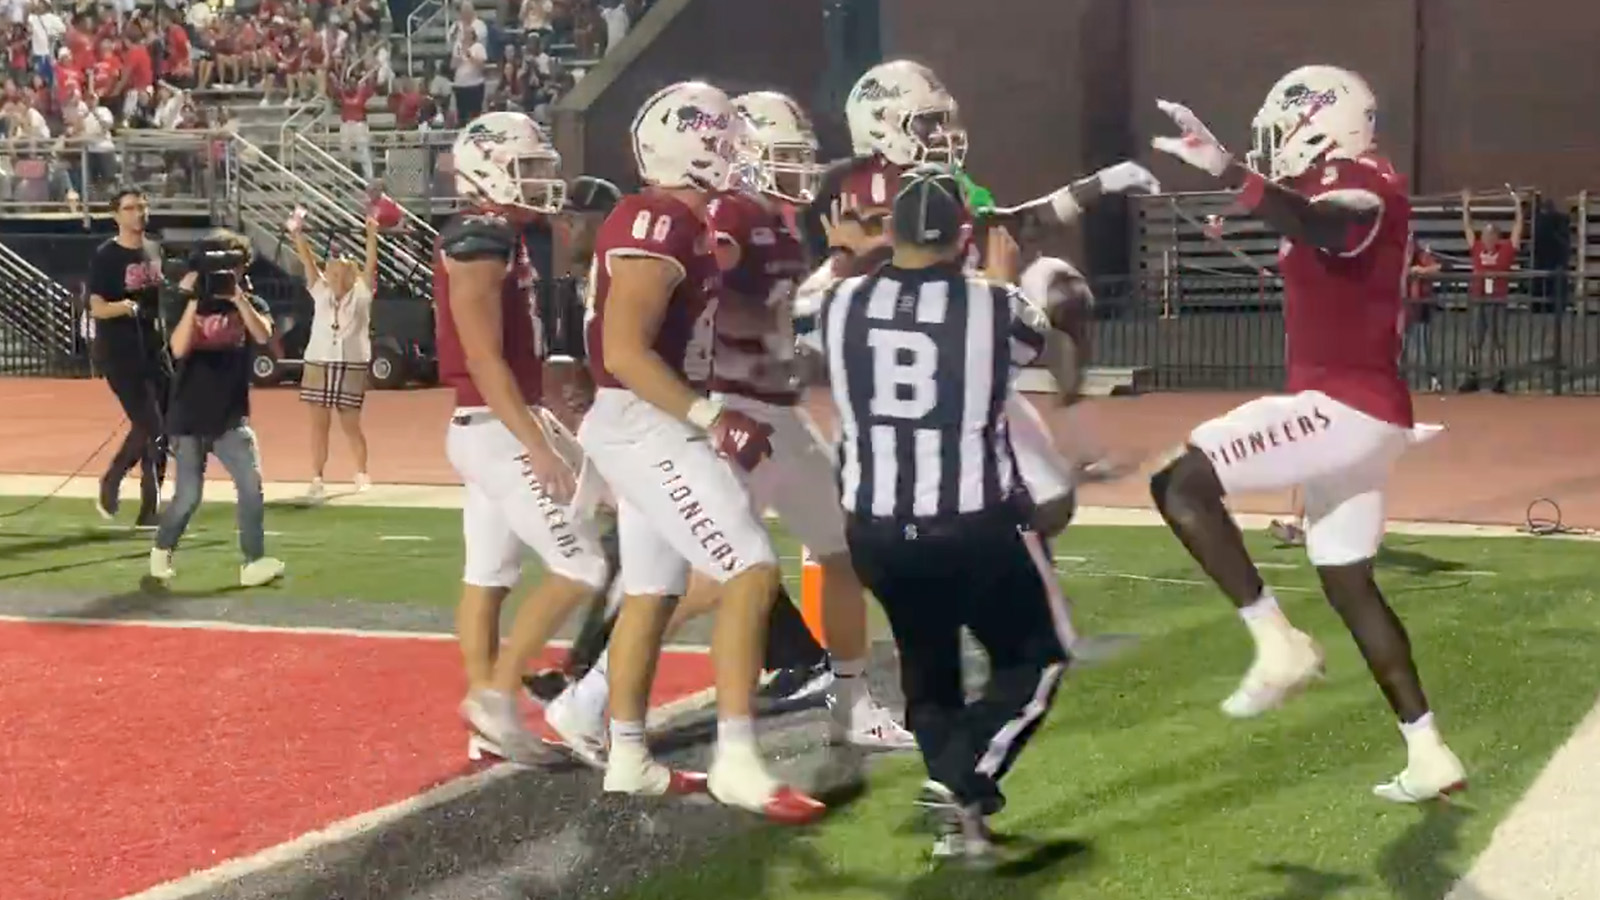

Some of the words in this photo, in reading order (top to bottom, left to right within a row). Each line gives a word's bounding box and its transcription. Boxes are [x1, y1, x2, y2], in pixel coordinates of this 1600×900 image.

[867, 327, 938, 420] B
[1208, 407, 1331, 465] IONEERS
[650, 459, 743, 572] PIONEERS
